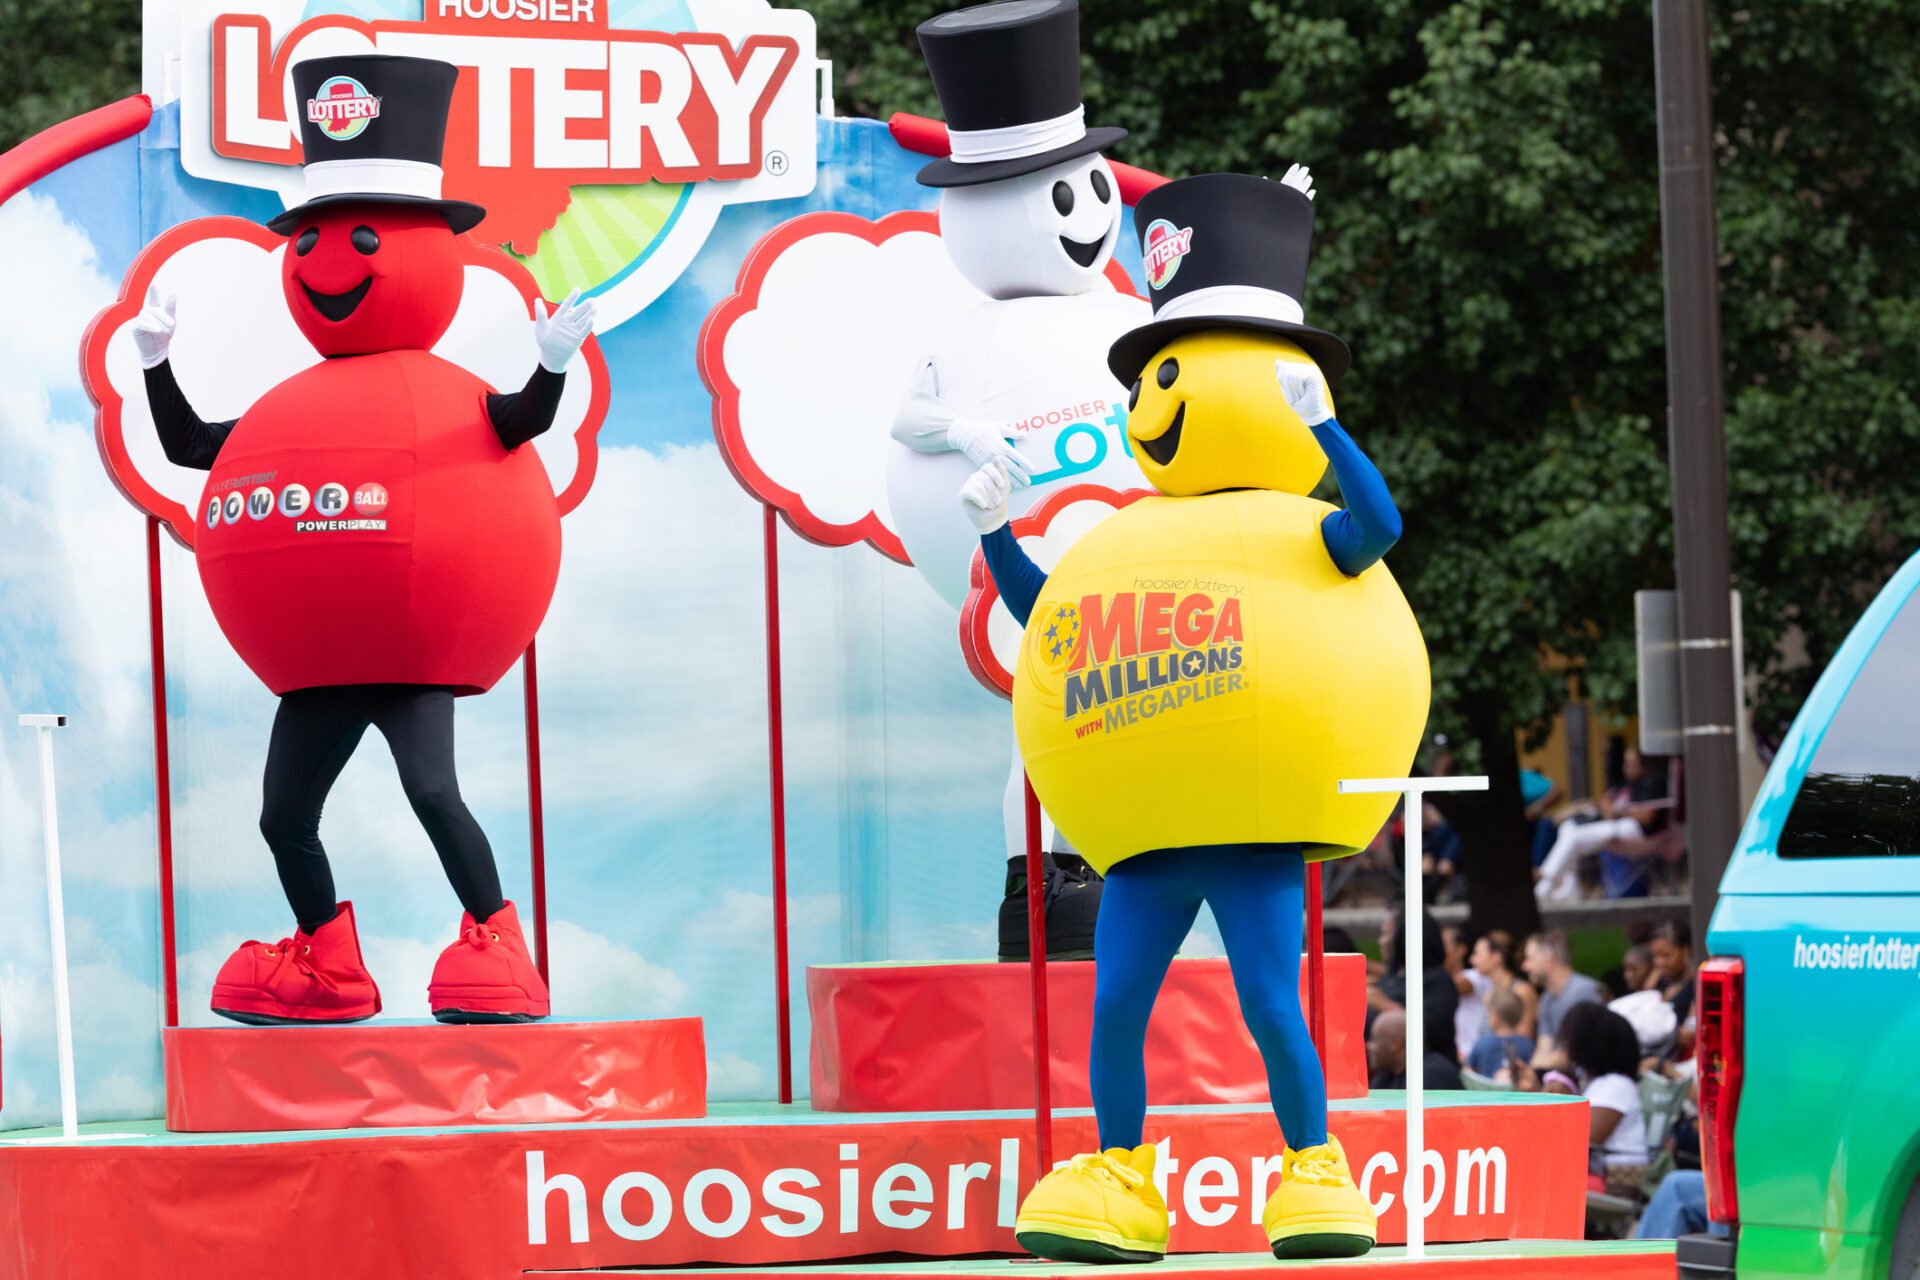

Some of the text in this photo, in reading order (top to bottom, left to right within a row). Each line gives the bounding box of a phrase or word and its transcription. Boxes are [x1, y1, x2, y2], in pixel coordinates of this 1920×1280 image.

[439, 0, 595, 23] HOOSIER
[308, 98, 378, 120] LOTTERY
[1144, 231, 1190, 276] OTTERY
[1016, 400, 1106, 432] HOOSIER
[1066, 592, 1244, 674] MEGA
[1065, 646, 1243, 720] MILLIONS
[1075, 674, 1243, 739] WITH MEGAPLIER
[1793, 934, 1920, 977] hoosierlotter
